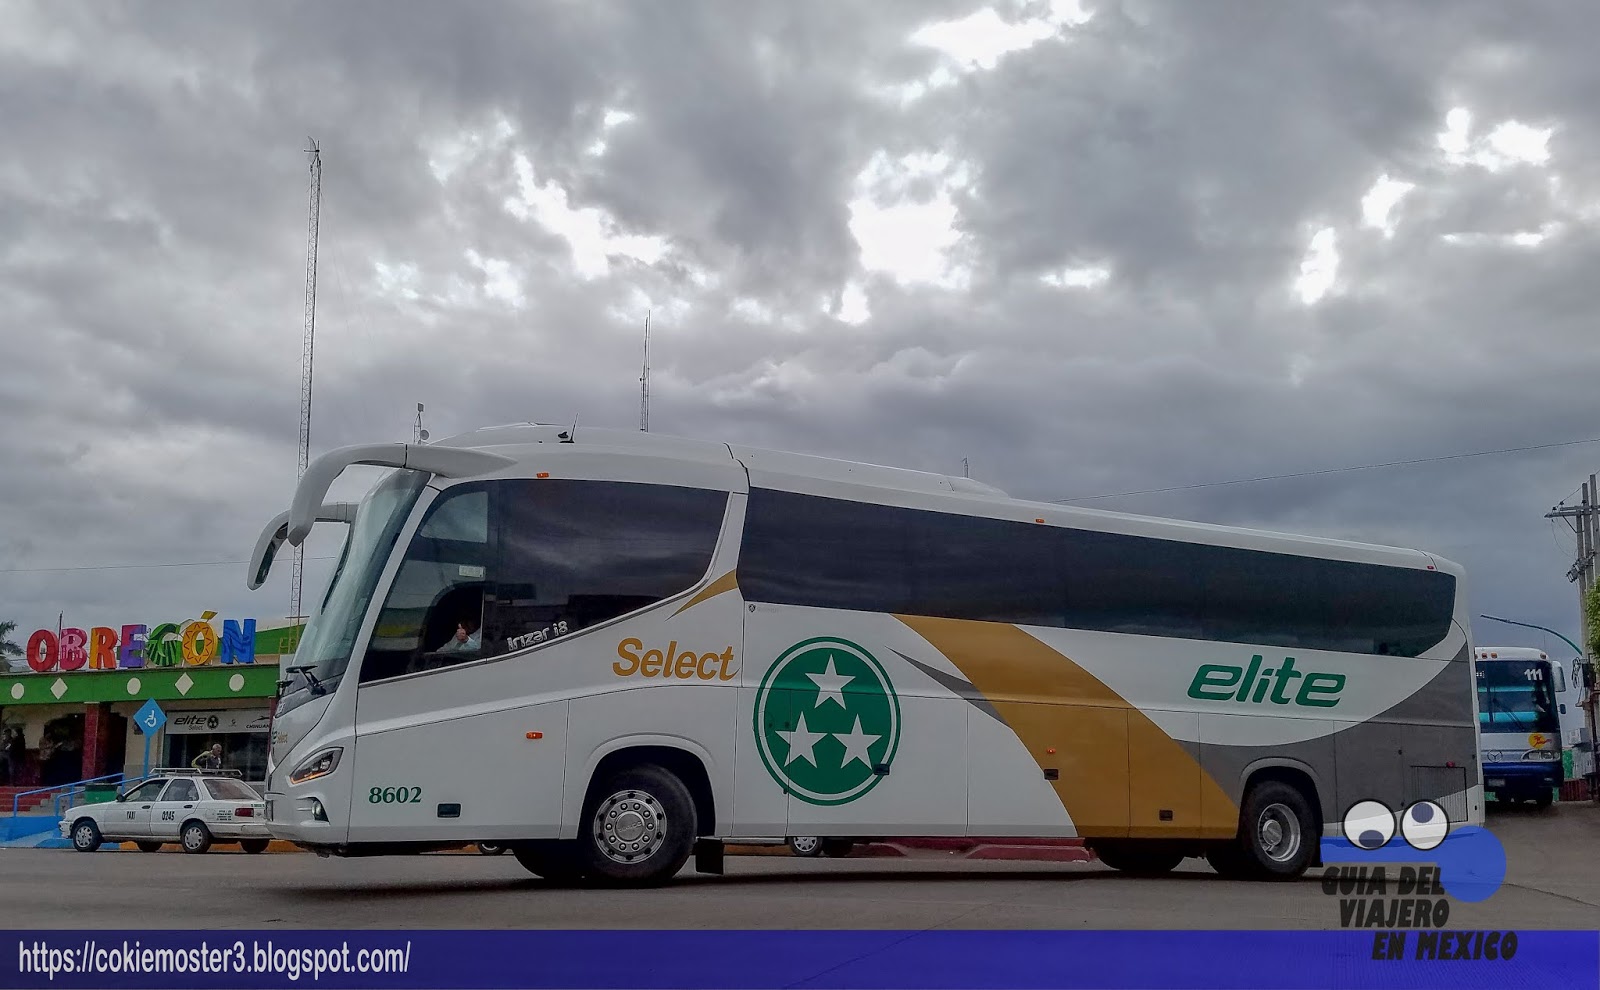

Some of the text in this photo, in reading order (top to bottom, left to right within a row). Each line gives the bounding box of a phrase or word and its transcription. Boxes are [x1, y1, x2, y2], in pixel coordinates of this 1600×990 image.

[552, 620, 568, 636] i8
[27, 611, 256, 672] OBREGÓN
[612, 637, 740, 681] Select
[1187, 654, 1347, 708] elite
[1524, 668, 1543, 681] 111
[174, 714, 207, 726] elite
[368, 786, 422, 803] 8602
[126, 811, 136, 820] TAXI
[162, 810, 175, 821] 0245
